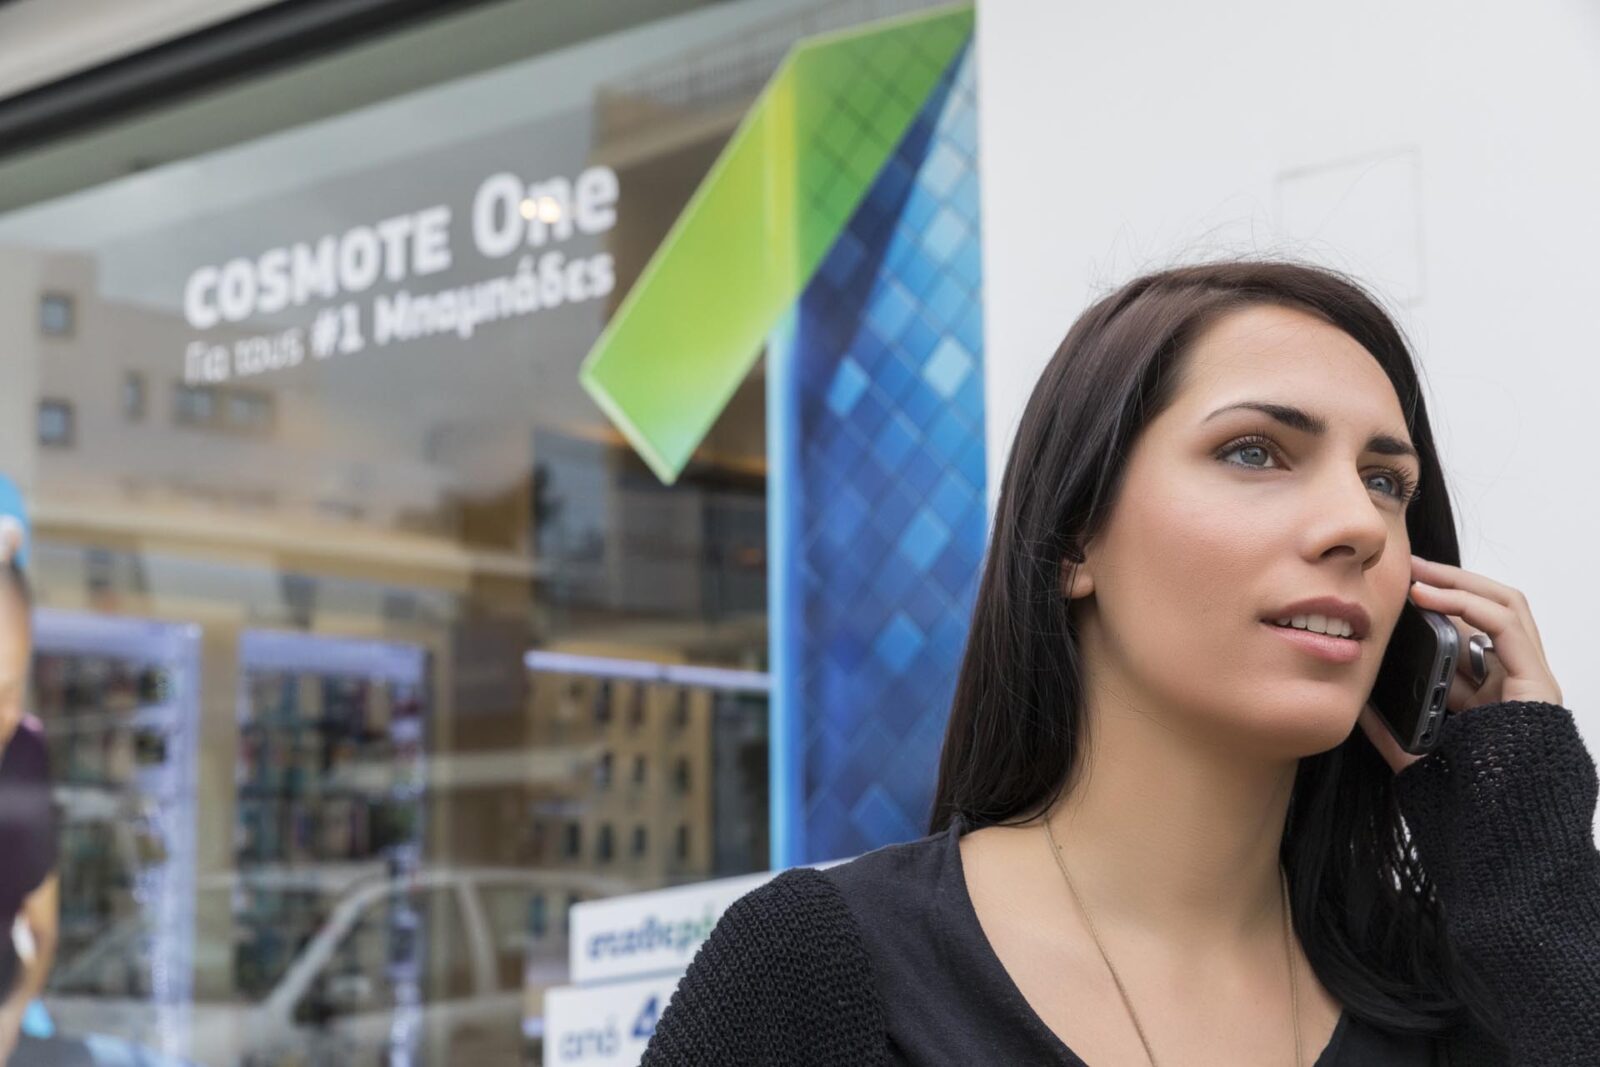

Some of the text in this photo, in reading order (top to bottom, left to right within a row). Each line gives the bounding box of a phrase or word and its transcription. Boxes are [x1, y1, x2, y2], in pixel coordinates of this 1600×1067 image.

[184, 166, 619, 329] COSMOTE One
[310, 302, 365, 359] #1
